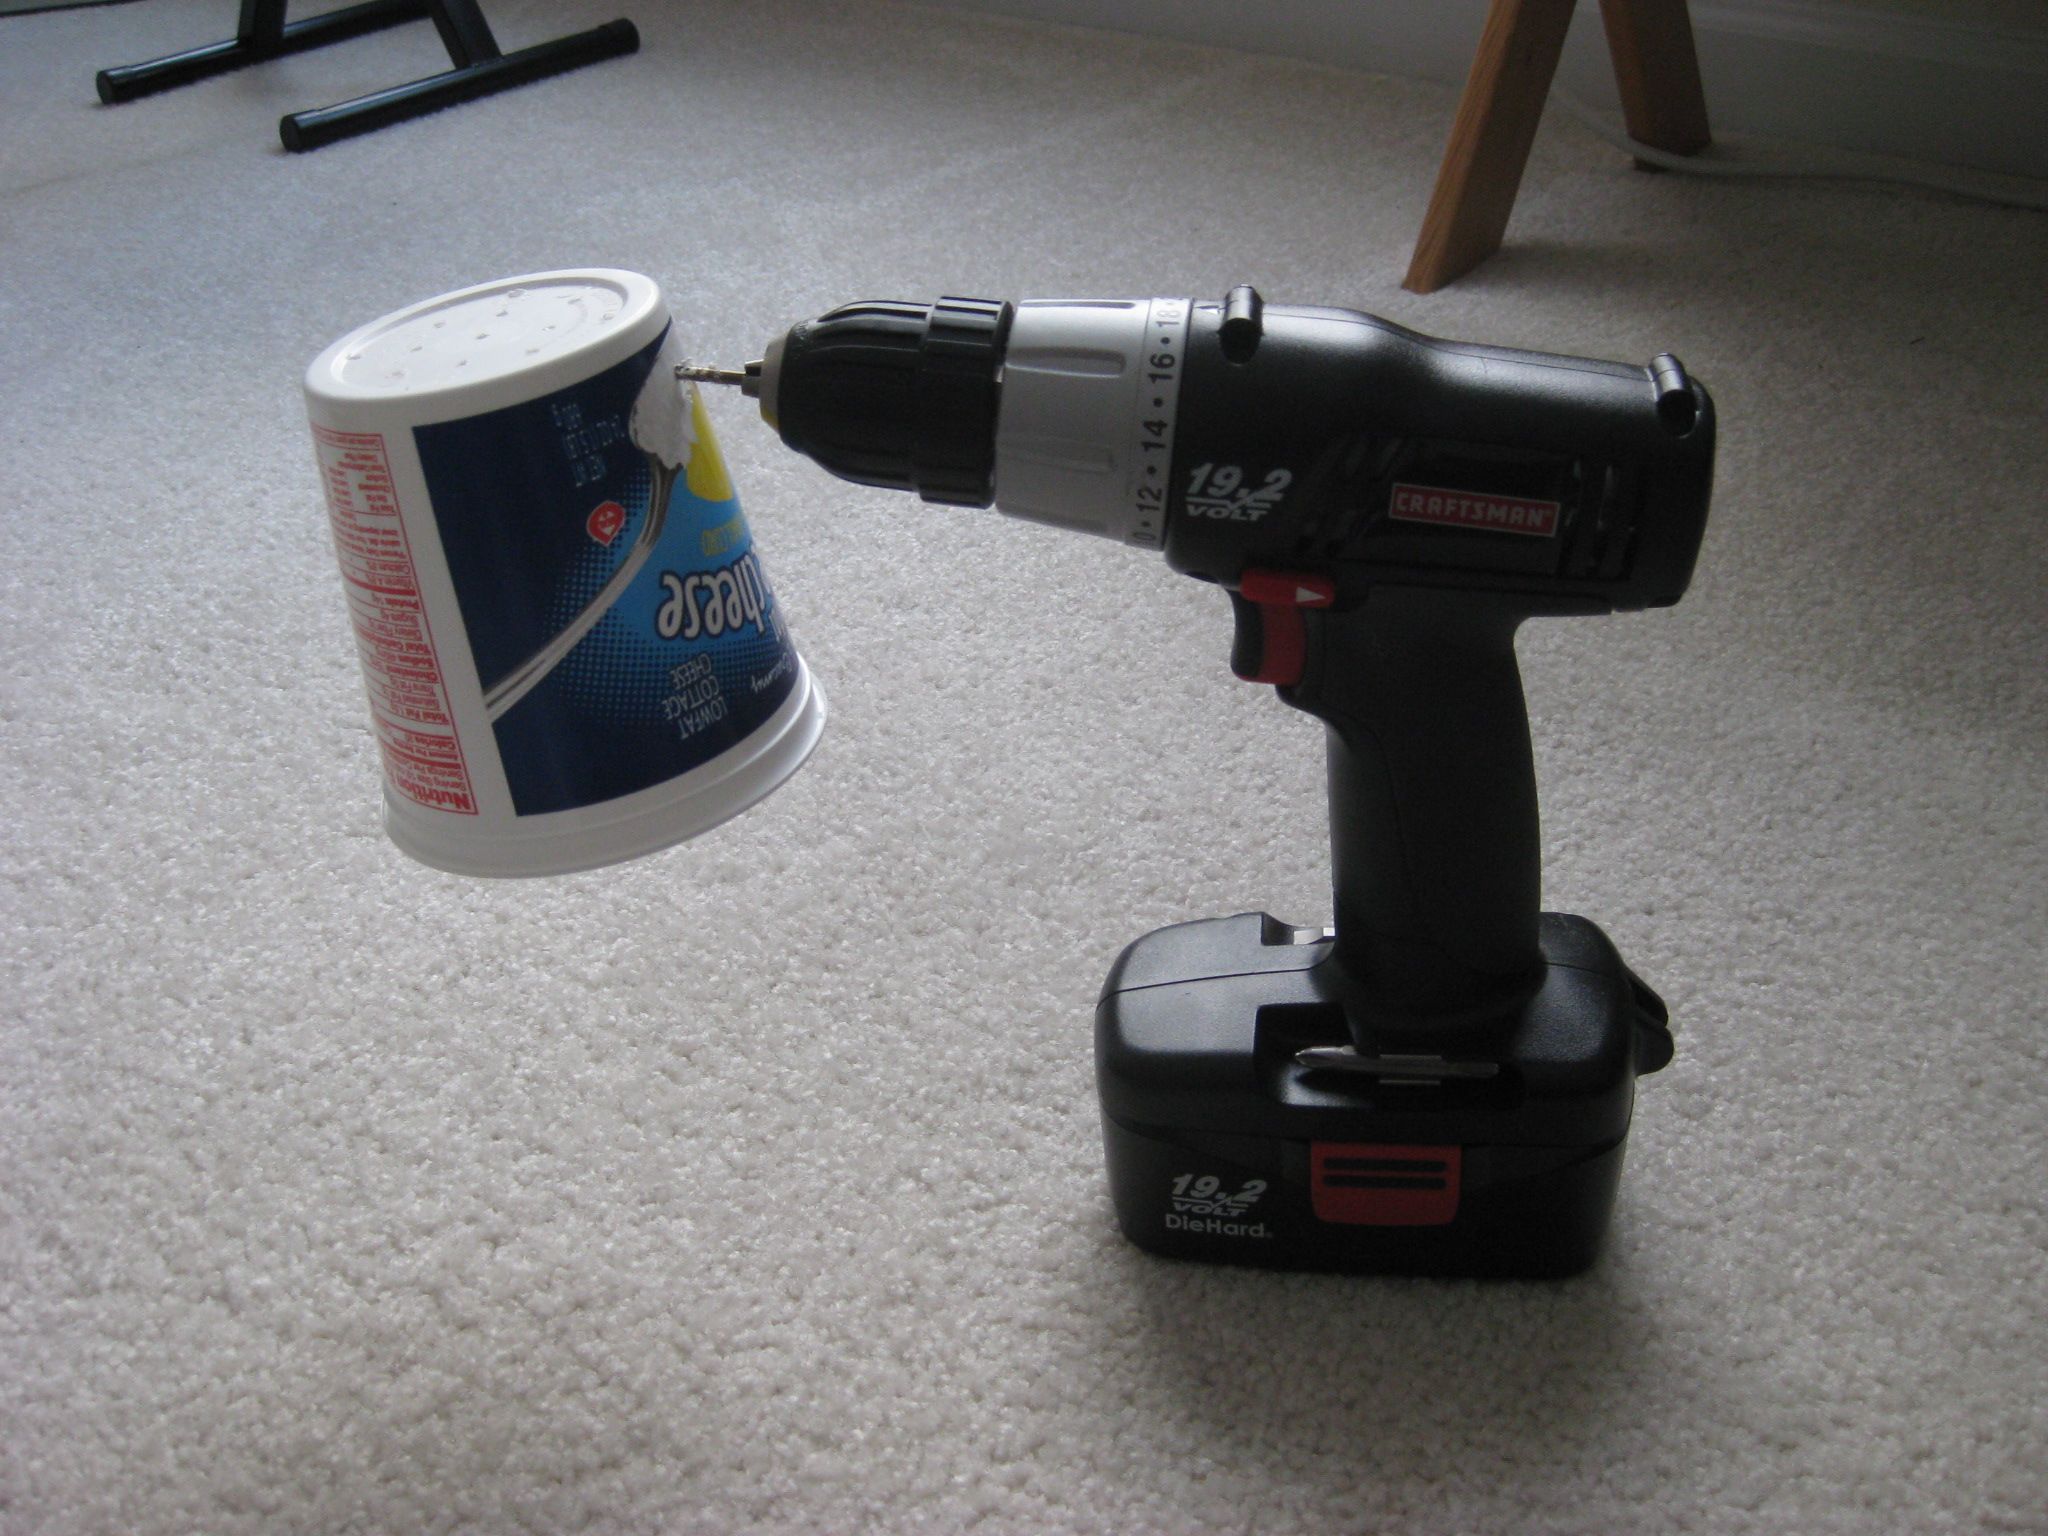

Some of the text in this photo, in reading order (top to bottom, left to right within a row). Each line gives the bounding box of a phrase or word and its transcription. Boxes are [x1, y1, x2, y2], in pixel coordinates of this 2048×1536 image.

[1149, 353, 1175, 384] 16
[1142, 418, 1168, 452] 14
[1187, 463, 1292, 500] 19.2
[1136, 487, 1163, 513] 12
[1186, 502, 1270, 522] VOLT
[659, 554, 766, 638] cheese
[670, 654, 712, 690] CHEESE
[662, 675, 721, 720] COTTAGE
[677, 696, 728, 740] LOWFAT
[396, 776, 472, 811] Nutrition
[1171, 1173, 1267, 1200] 19.2
[1164, 1213, 1267, 1239] DieHard
[1173, 1201, 1249, 1218] VOLT
